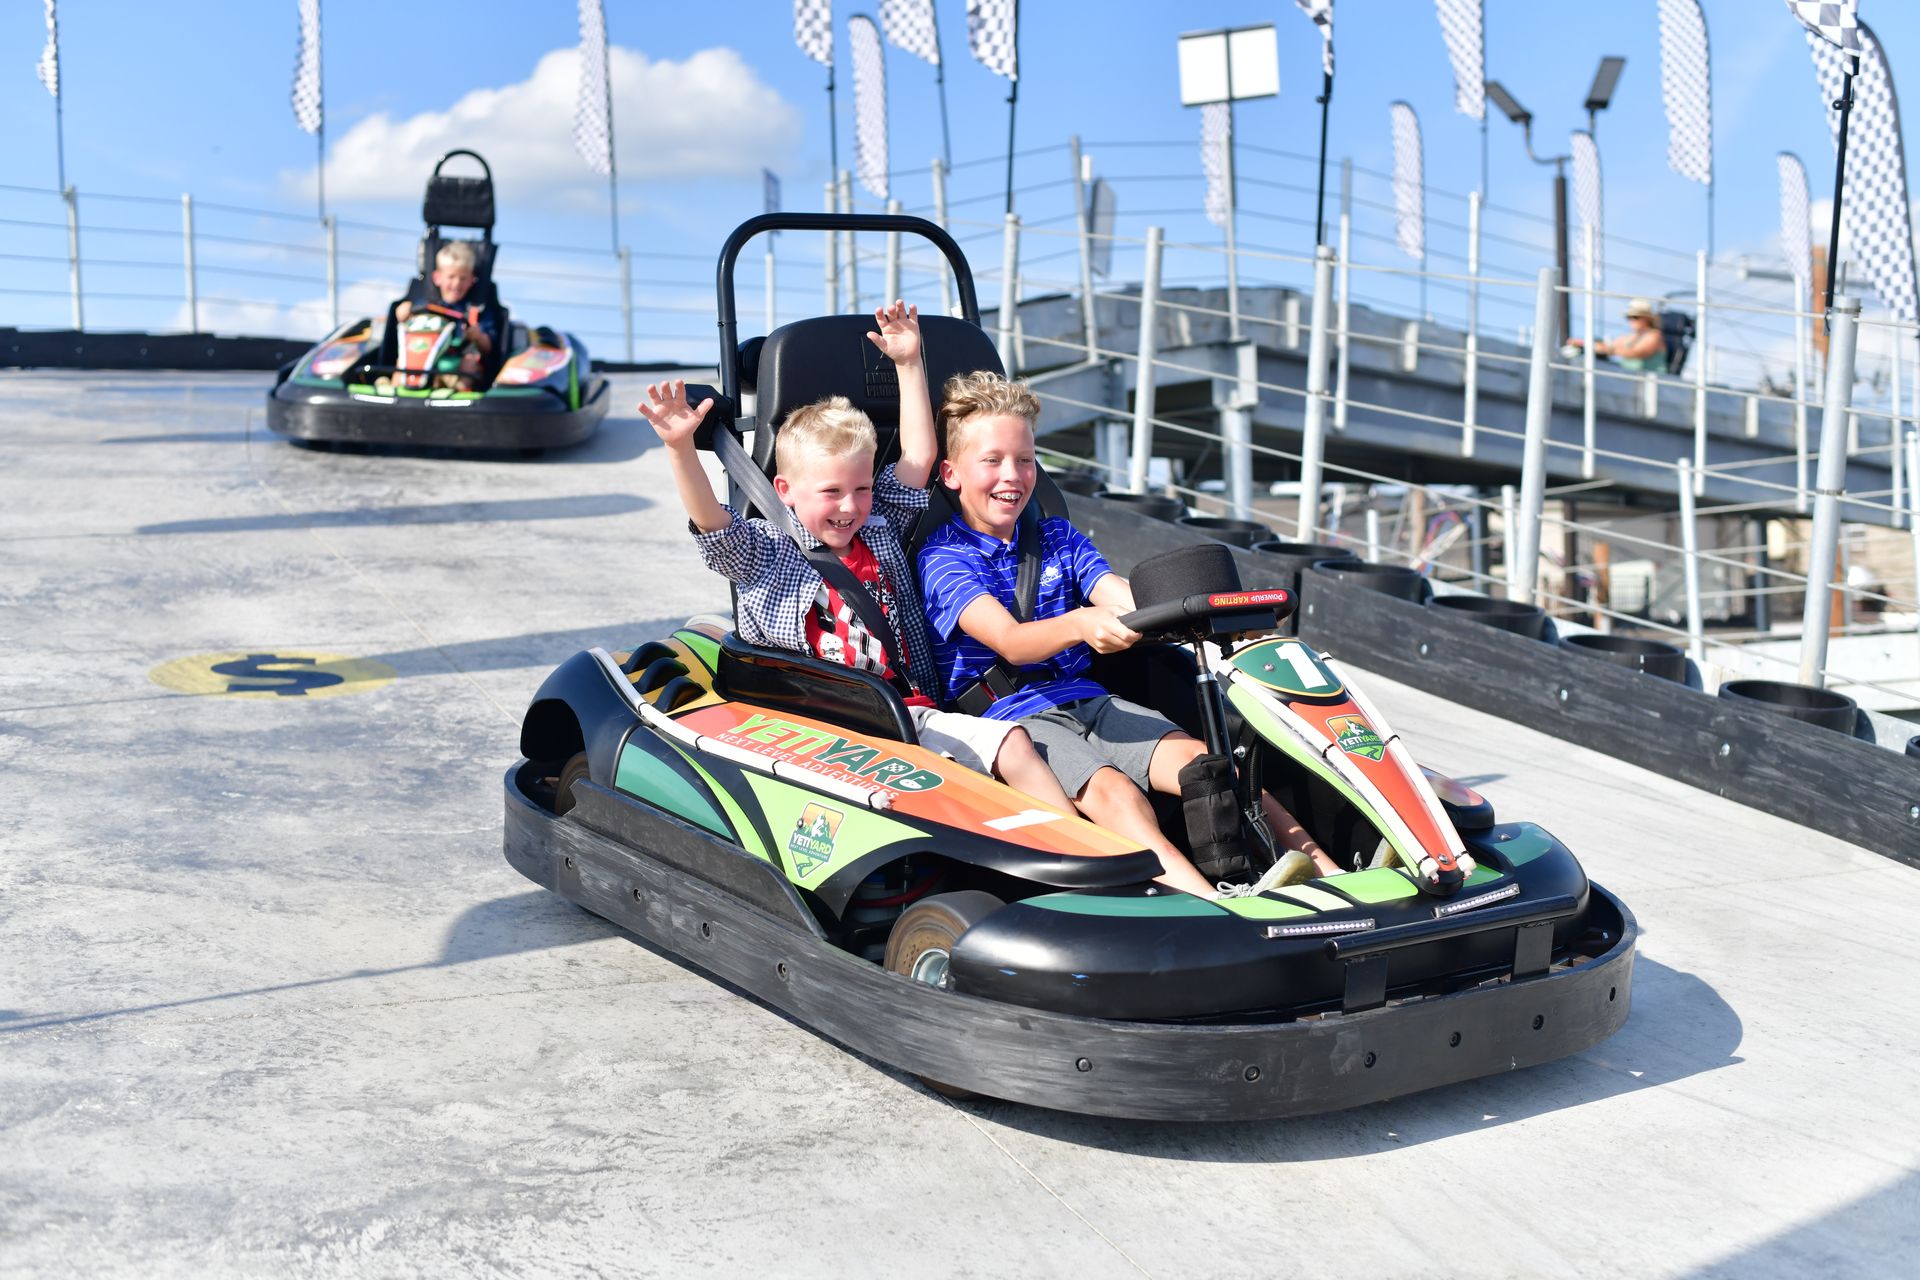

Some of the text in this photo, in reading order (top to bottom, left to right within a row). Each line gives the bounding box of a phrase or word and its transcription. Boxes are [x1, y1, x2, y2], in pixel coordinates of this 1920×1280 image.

[1214, 596, 1249, 606] KARTING
[1274, 642, 1329, 690] 1
[715, 733, 755, 750] NEXT
[752, 744, 796, 764] LEVEL
